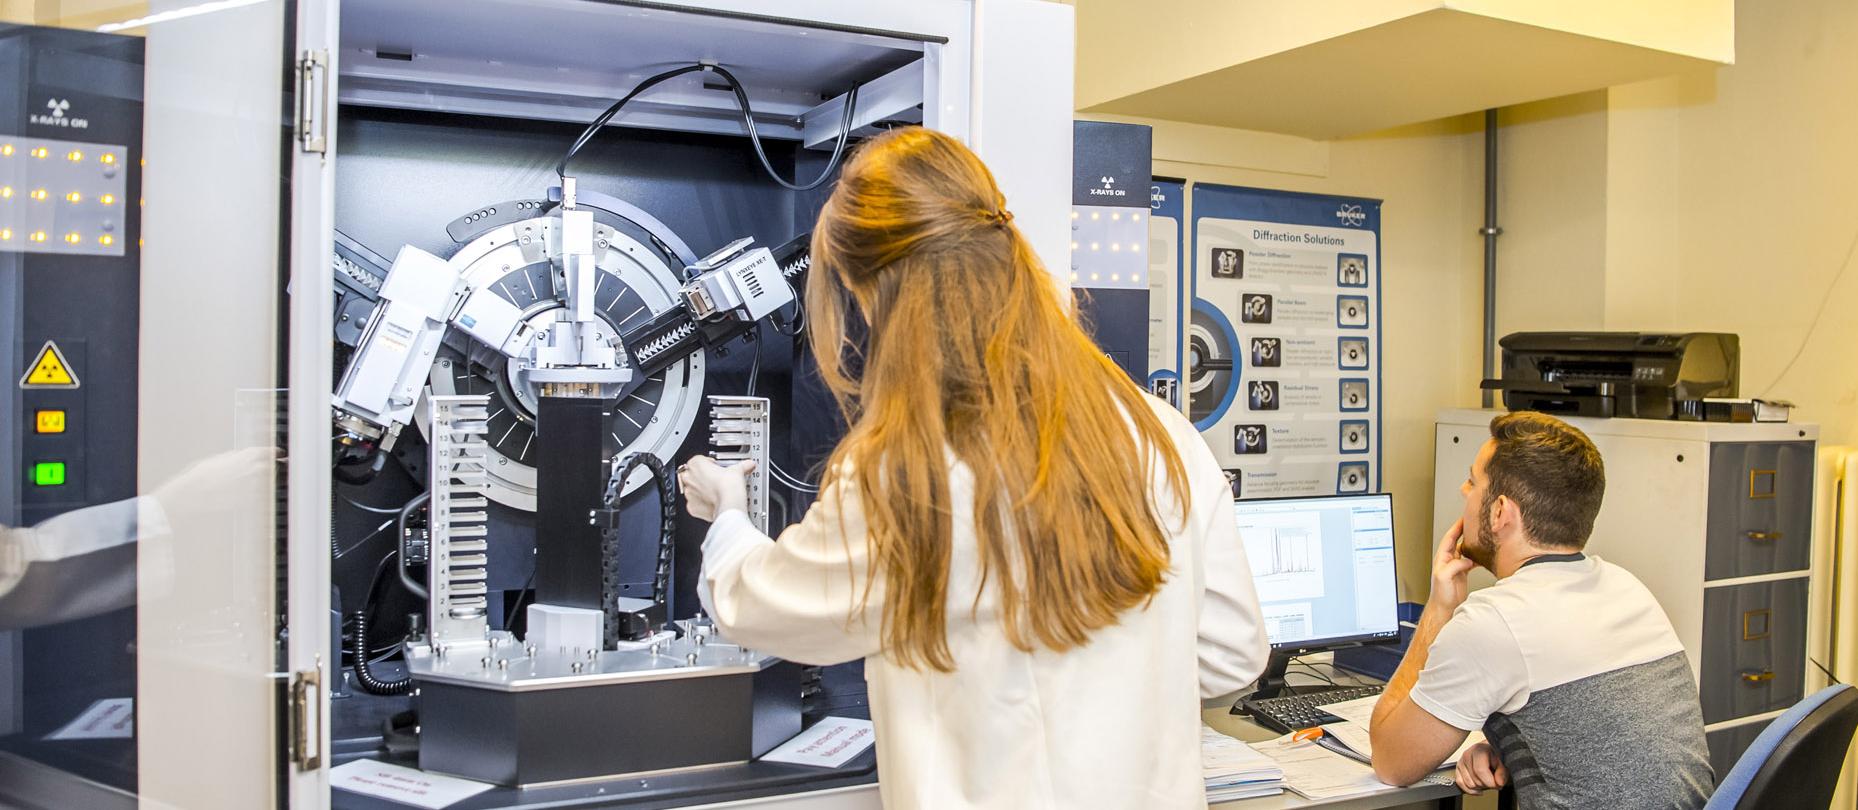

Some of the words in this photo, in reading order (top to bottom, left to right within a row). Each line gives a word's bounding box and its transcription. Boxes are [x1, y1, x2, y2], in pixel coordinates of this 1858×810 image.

[30, 115, 69, 127] X-RAYS
[70, 118, 88, 128] ON
[1090, 188, 1114, 196] X-RAYS
[1253, 229, 1302, 242] Diffraction
[1303, 233, 1345, 246] Solutions
